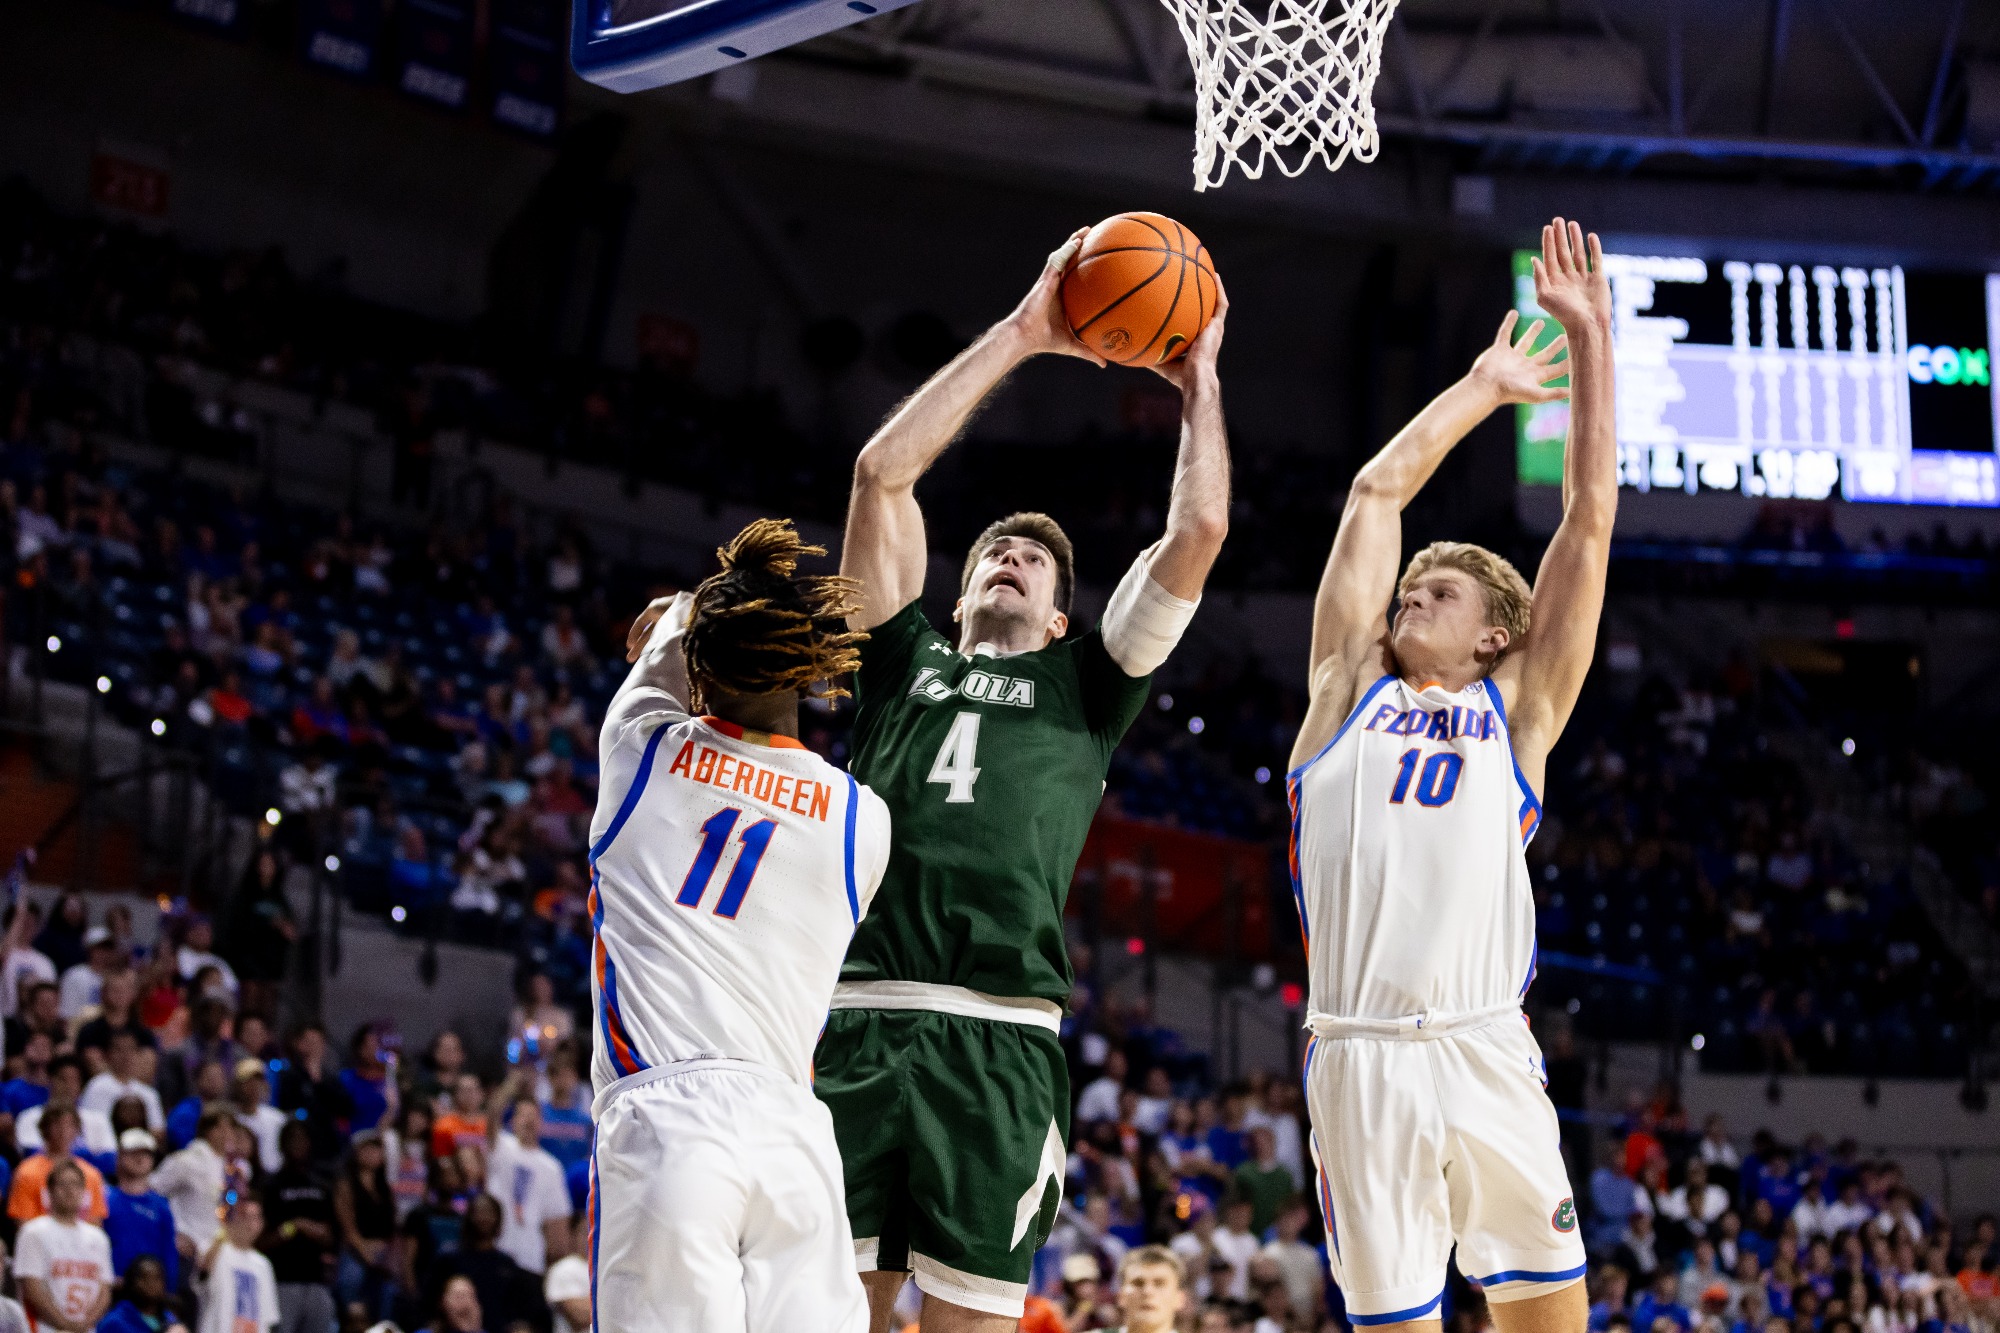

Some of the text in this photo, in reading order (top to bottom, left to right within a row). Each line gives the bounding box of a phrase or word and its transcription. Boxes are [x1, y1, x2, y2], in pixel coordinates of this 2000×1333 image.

[1907, 344, 1990, 387] COX
[906, 667, 1034, 708] LOOLA
[1363, 703, 1499, 742] FLORIDA
[668, 740, 832, 822] ABERDEEN
[926, 711, 981, 803] 4
[1389, 747, 1465, 809] 10
[674, 806, 779, 920] 11
